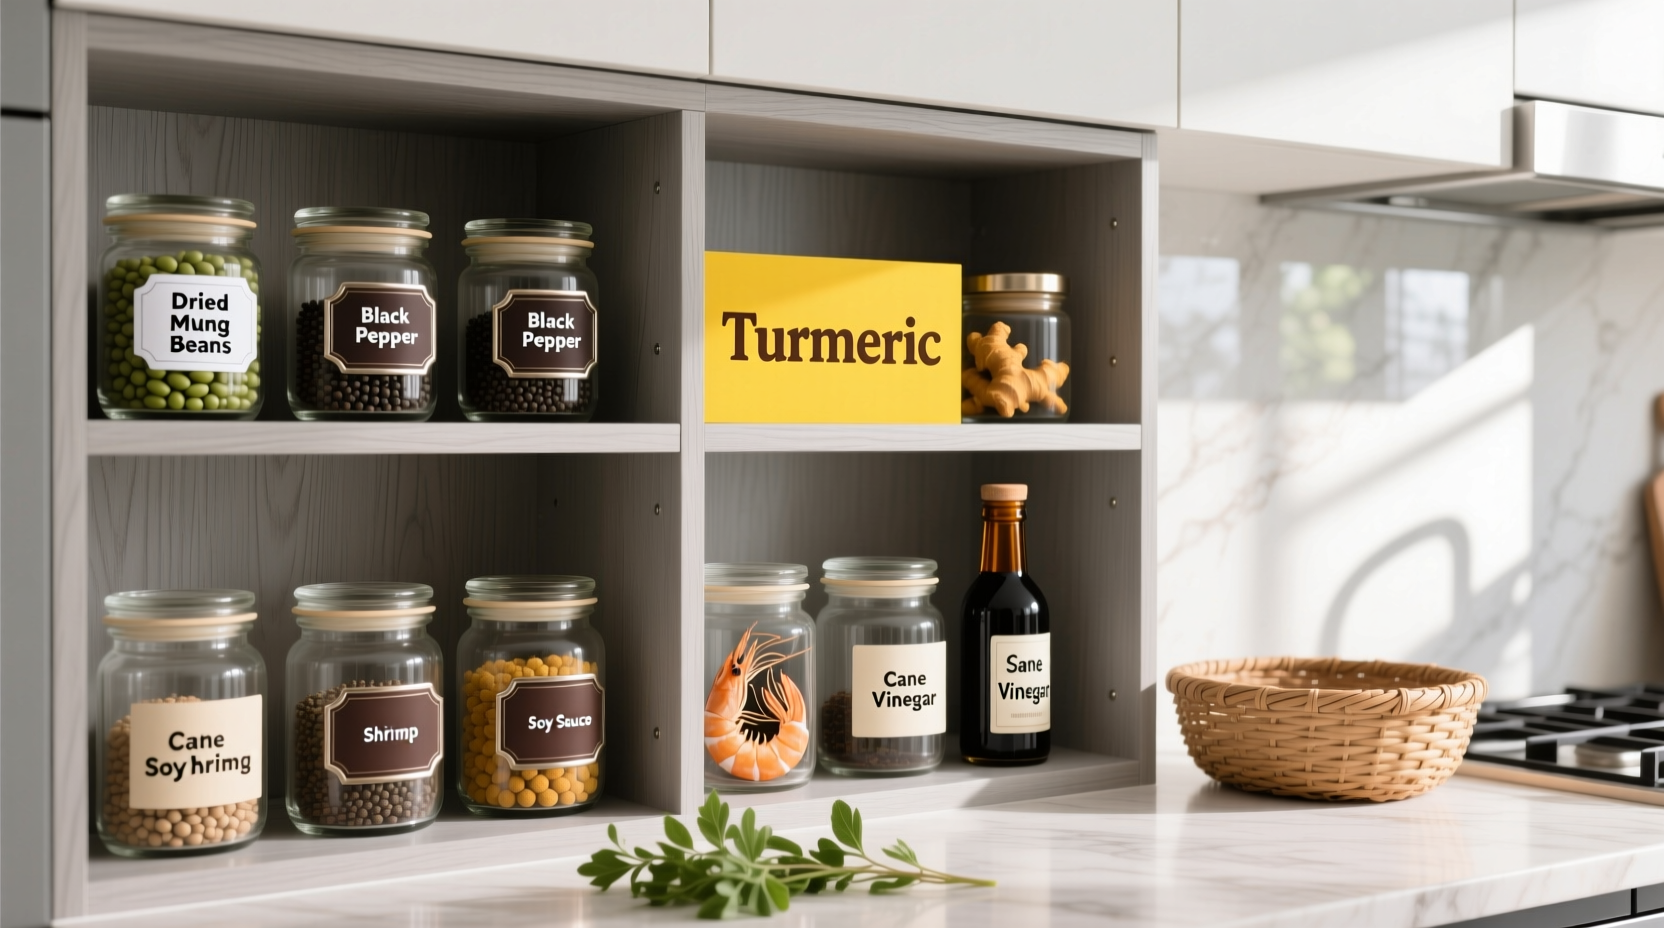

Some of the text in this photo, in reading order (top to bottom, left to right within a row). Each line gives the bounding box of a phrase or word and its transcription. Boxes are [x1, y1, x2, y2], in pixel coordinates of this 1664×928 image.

[172, 292, 229, 311] Dried
[361, 306, 410, 324] Black
[528, 311, 575, 329] Black
[170, 314, 230, 337] Mung
[170, 335, 232, 354] Beans
[355, 326, 419, 349] Pepper
[522, 331, 582, 353] Pepper
[721, 311, 941, 366] Turmeric
[1006, 654, 1043, 674] Sane
[883, 671, 927, 687] Cane
[871, 691, 937, 711] Vinegar
[998, 682, 1050, 705] Vinegar
[363, 725, 419, 744] Shrimp
[528, 715, 554, 734] Soy
[168, 731, 225, 751] Cane
